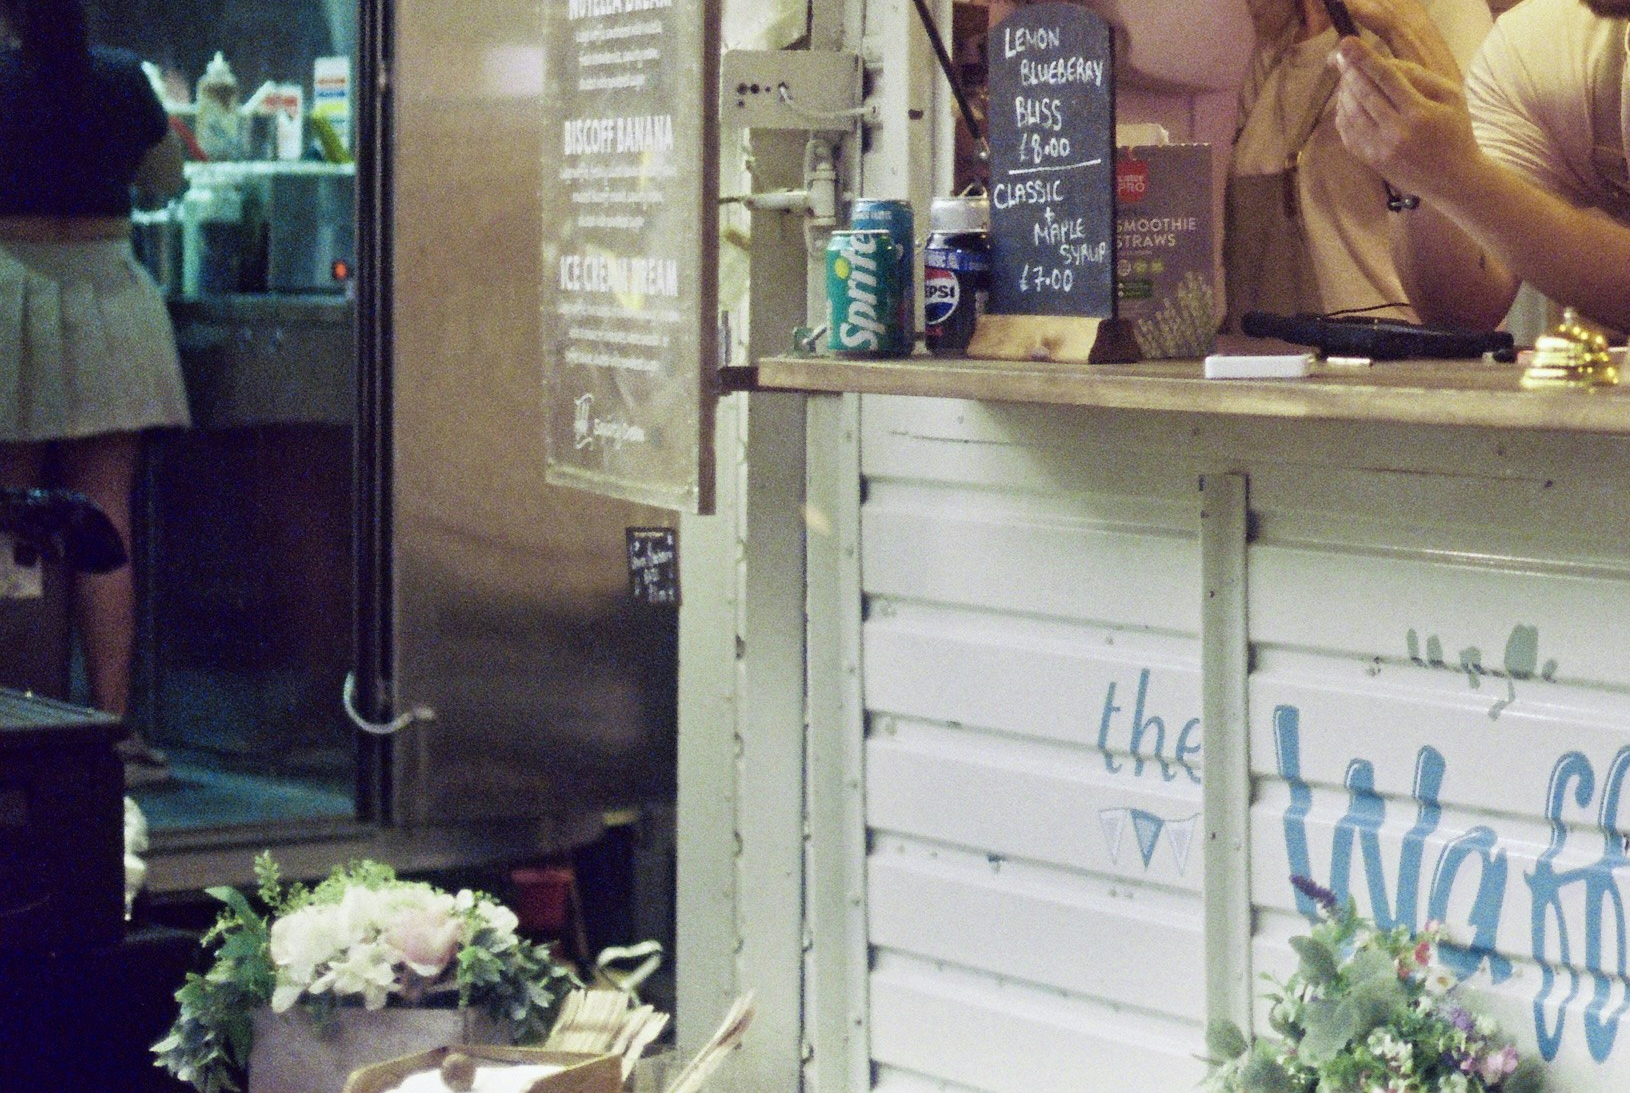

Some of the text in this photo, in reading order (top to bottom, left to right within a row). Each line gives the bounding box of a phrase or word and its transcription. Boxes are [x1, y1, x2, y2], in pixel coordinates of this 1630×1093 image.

[1004, 27, 1060, 59] LEMON
[1020, 57, 1103, 87] BLUEBERRY
[1015, 96, 1062, 131] BLISS
[564, 115, 674, 155] BISCOFF BANANA
[1019, 133, 1071, 164] £8.00
[993, 179, 1064, 209] CLASSIC
[1034, 218, 1086, 246] MAPLE
[1117, 217, 1198, 233] SMOOTHIE
[1060, 242, 1106, 265] SYRUP
[1117, 233, 1177, 249] STRAWS
[560, 255, 581, 291] ICE
[631, 258, 678, 297] DREAM
[1019, 262, 1073, 293] £7.00
[840, 233, 887, 352] Sprite
[1097, 667, 1201, 784] the
